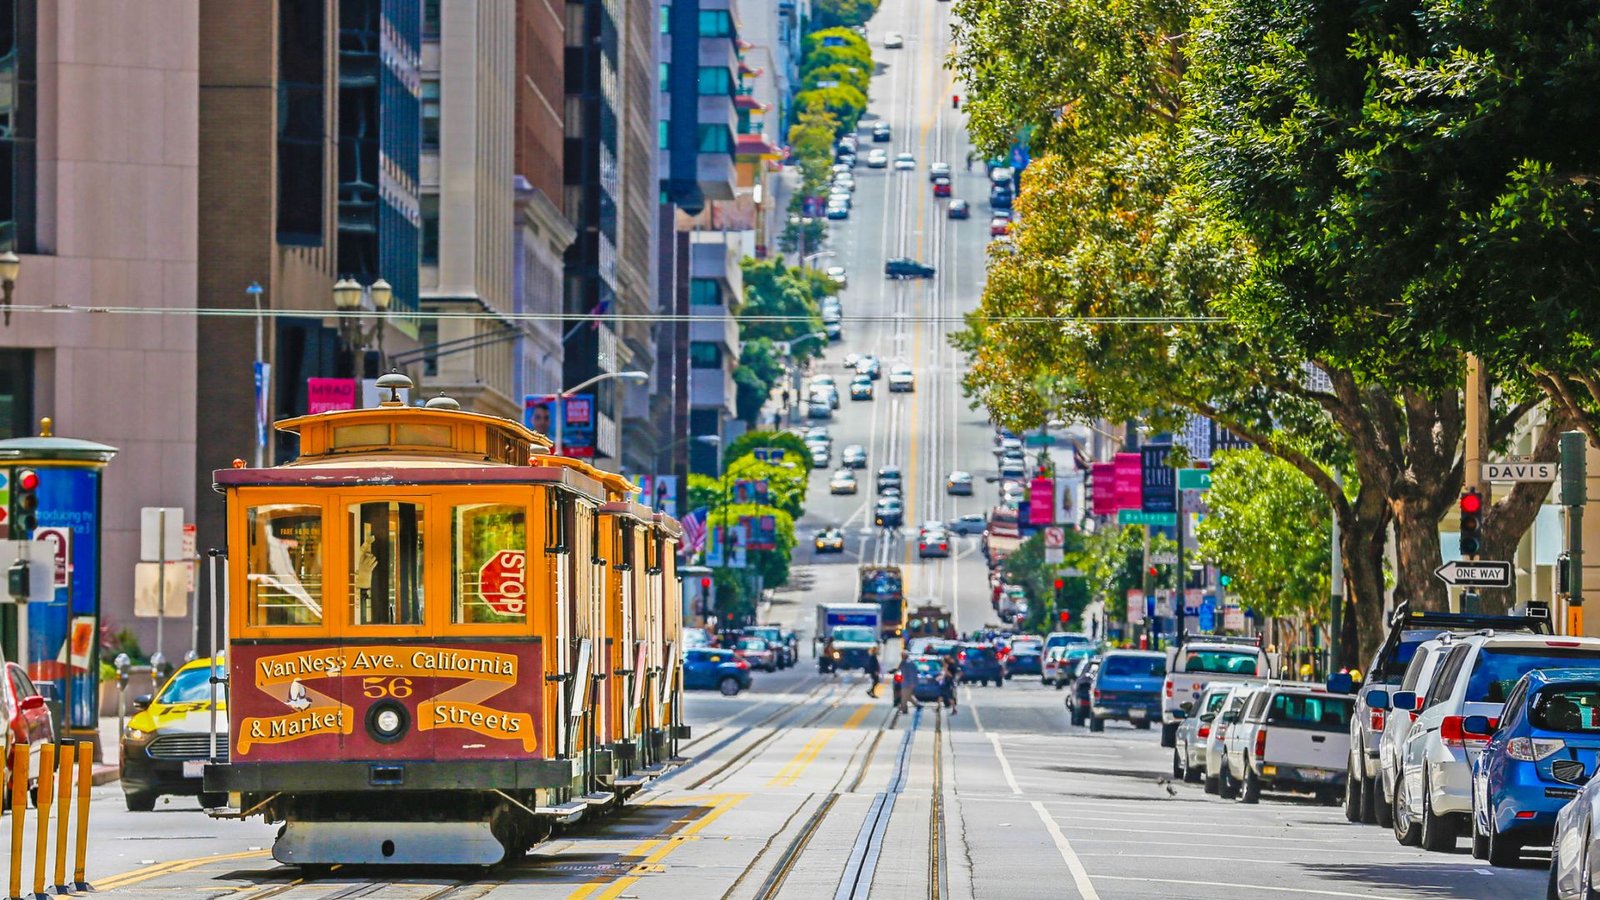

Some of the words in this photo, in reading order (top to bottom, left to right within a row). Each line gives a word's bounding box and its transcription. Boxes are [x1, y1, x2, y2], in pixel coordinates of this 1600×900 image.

[1489, 466, 1548, 478] DAVIS
[500, 554, 525, 612] STOP
[1456, 568, 1476, 578] ONE
[1480, 568, 1501, 578] WAY
[261, 660, 296, 678] Van
[298, 655, 347, 673] Ness
[412, 651, 513, 675] California
[363, 677, 413, 698] 56
[251, 720, 265, 738] &
[270, 710, 343, 738] Market
[434, 705, 520, 732] Streets
